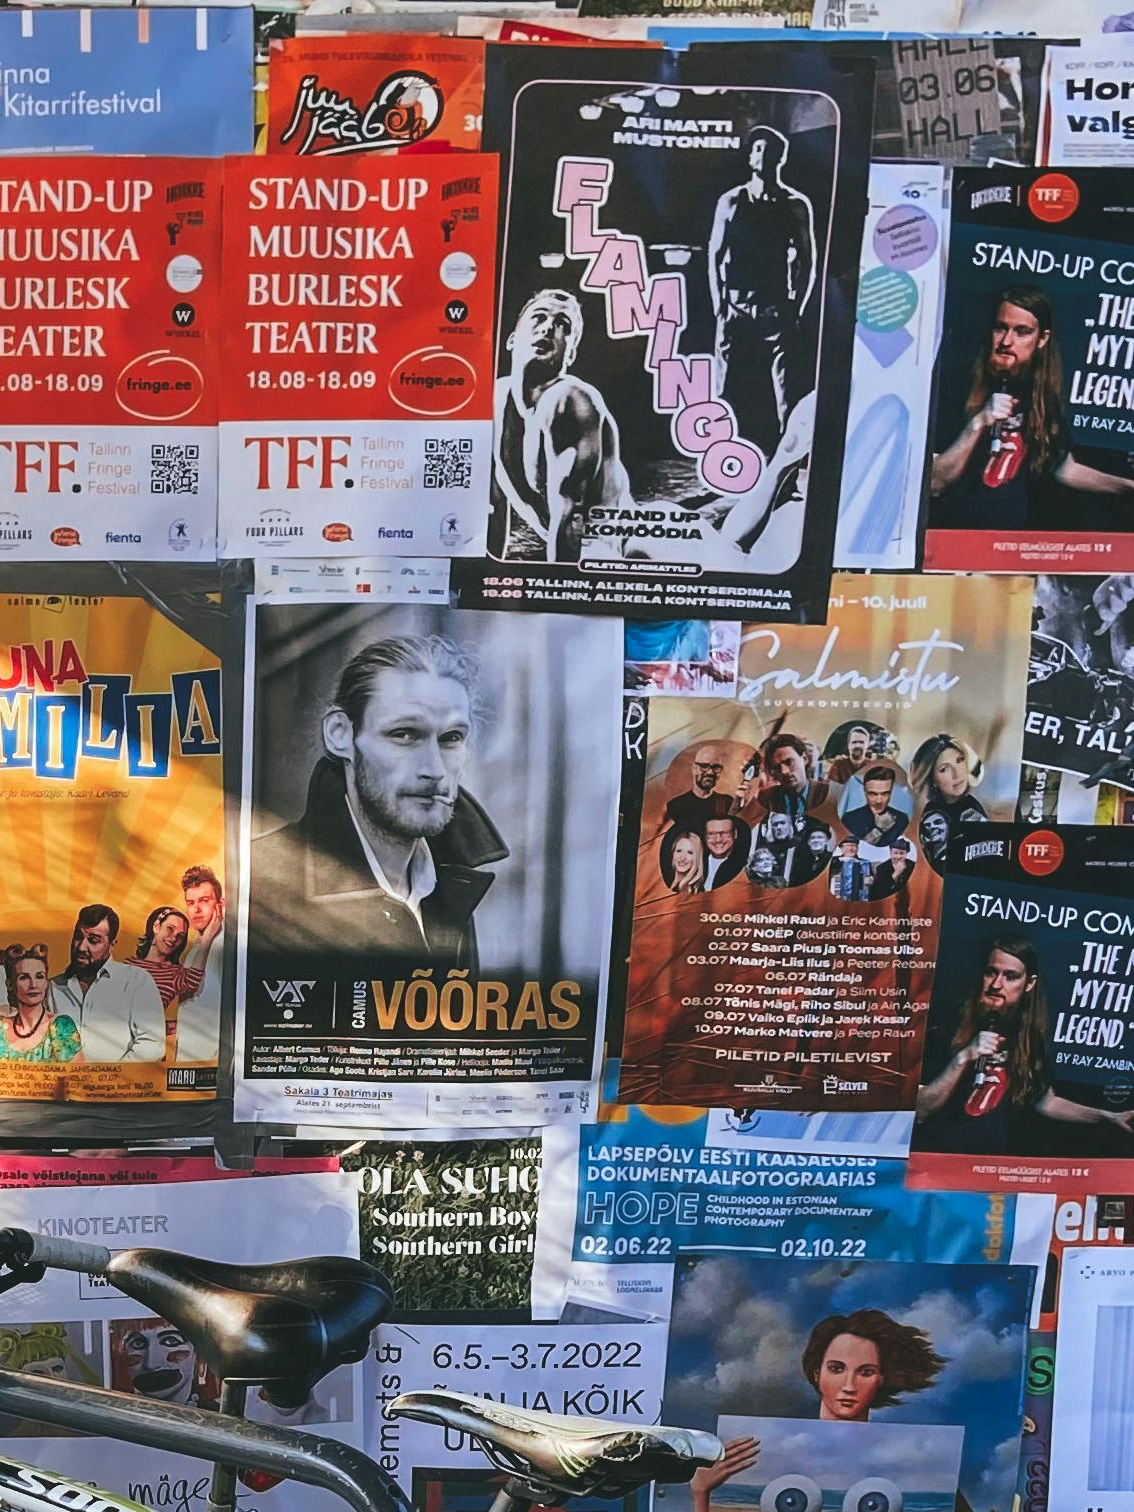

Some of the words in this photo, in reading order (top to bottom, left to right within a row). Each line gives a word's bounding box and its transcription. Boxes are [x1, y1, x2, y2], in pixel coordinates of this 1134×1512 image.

[898, 64, 996, 105] 03.06
[4, 87, 162, 118] Kitarrifestival
[622, 116, 661, 131] ARI
[664, 119, 733, 133] MATTI
[907, 108, 998, 149] HALL
[613, 132, 741, 149] MUSTONEN
[248, 177, 429, 211] STAND-UP
[248, 225, 414, 260] MUUSIKA
[971, 241, 1095, 280] STAND-UP
[248, 273, 402, 307] BURLESK
[556, 157, 764, 494] FLAMINGO
[245, 321, 379, 354] TEATER
[125, 377, 193, 394] fringe.ee
[246, 371, 377, 389] 18.08-18.09
[399, 371, 465, 388] fringe.ee
[87, 442, 132, 456] Tallinn
[361, 437, 404, 450] Tallinn
[87, 461, 133, 477] Fringe
[360, 456, 405, 472] Fringe
[87, 480, 141, 495] Festival
[360, 475, 414, 490] Festival
[590, 507, 667, 522] STAND
[669, 510, 701, 523] UP
[105, 531, 142, 544] fienta
[378, 527, 414, 539] fienta
[526, 577, 593, 591] TALLINN,
[596, 580, 663, 592] ALEXELA
[666, 583, 793, 599] KONTSERDIMAJA
[525, 590, 592, 603] TALLINN,
[594, 592, 661, 604] ALEXELA
[664, 595, 792, 611] KONTSERDIMAJA
[886, 596, 927, 614] juuli
[739, 625, 965, 702] Salmistu
[965, 893, 1077, 929] STAND-UP
[699, 913, 742, 923] 30.06
[744, 913, 789, 925] Mihkel
[792, 915, 826, 926] Raud
[869, 917, 933, 927] Kammiste
[713, 927, 751, 937] 01.07
[753, 926, 794, 939] NOËP
[796, 928, 861, 941] (akustiline
[863, 930, 921, 942] kontsert)
[708, 941, 750, 952] 02.07
[750, 943, 791, 953] Saara
[837, 945, 892, 955] Toomas
[686, 956, 728, 966] 03.07
[729, 956, 806, 969] Maarja-Liis
[847, 959, 889, 969] Peeter
[765, 972, 807, 982] 06.07
[808, 972, 863, 984] Rändaja
[714, 983, 754, 994] 07.07
[352, 980, 367, 1030] CAMUS
[370, 967, 582, 1032] VÕÕRAS
[715, 1048, 781, 1063] PILETID
[783, 1050, 893, 1064] PILETILEVIST
[1071, 1054, 1093, 1067] RAY
[284, 1084, 320, 1097] Sakala
[332, 1086, 394, 1100] Teatrimajas
[586, 1144, 693, 1165] LAPSEPÕLV
[699, 1149, 750, 1166] EESTI
[586, 1165, 877, 1187] DOKUMENTAALFOTOGRAAFIAS
[583, 1190, 700, 1226] HOPE
[706, 1194, 770, 1206] CHILDHOOD
[785, 1195, 838, 1206] ESTONIAN
[372, 1206, 484, 1227] Southern
[705, 1205, 794, 1217] CONTEMPORARY
[794, 1206, 874, 1218] DOCUMENTARY
[37, 1215, 170, 1238] KINOTEATER
[704, 1216, 786, 1228] PHOTOGRAPHY
[371, 1235, 483, 1257] Southern
[580, 1235, 673, 1256] 02.06.22
[780, 1238, 868, 1259] 02.10.22
[563, 1383, 646, 1417] KÕIK
